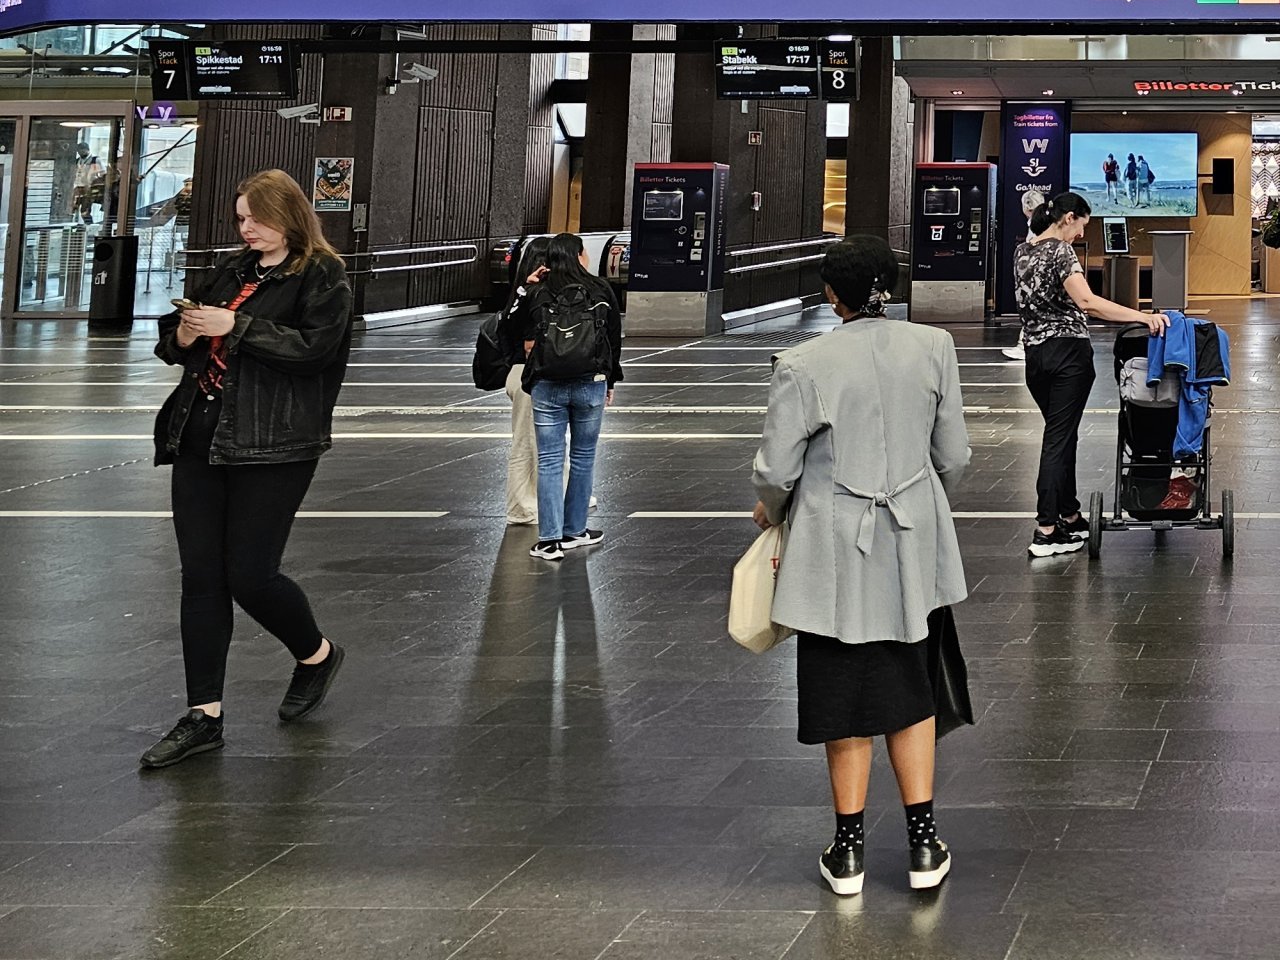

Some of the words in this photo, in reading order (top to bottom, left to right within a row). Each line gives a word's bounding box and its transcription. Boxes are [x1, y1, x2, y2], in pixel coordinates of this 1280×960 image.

[158, 50, 175, 60] Spor
[722, 54, 758, 65] Stabekk
[785, 55, 810, 65] 17:17
[829, 50, 846, 60] Spor
[158, 56, 178, 65] Track
[196, 55, 243, 66] Spikkestad
[258, 56, 283, 64] 17:11
[829, 56, 849, 66] Track
[163, 70, 176, 89] 7
[832, 70, 846, 90] 8
[1134, 81, 1233, 91] Billetter
[1030, 158, 1040, 167] SJ
